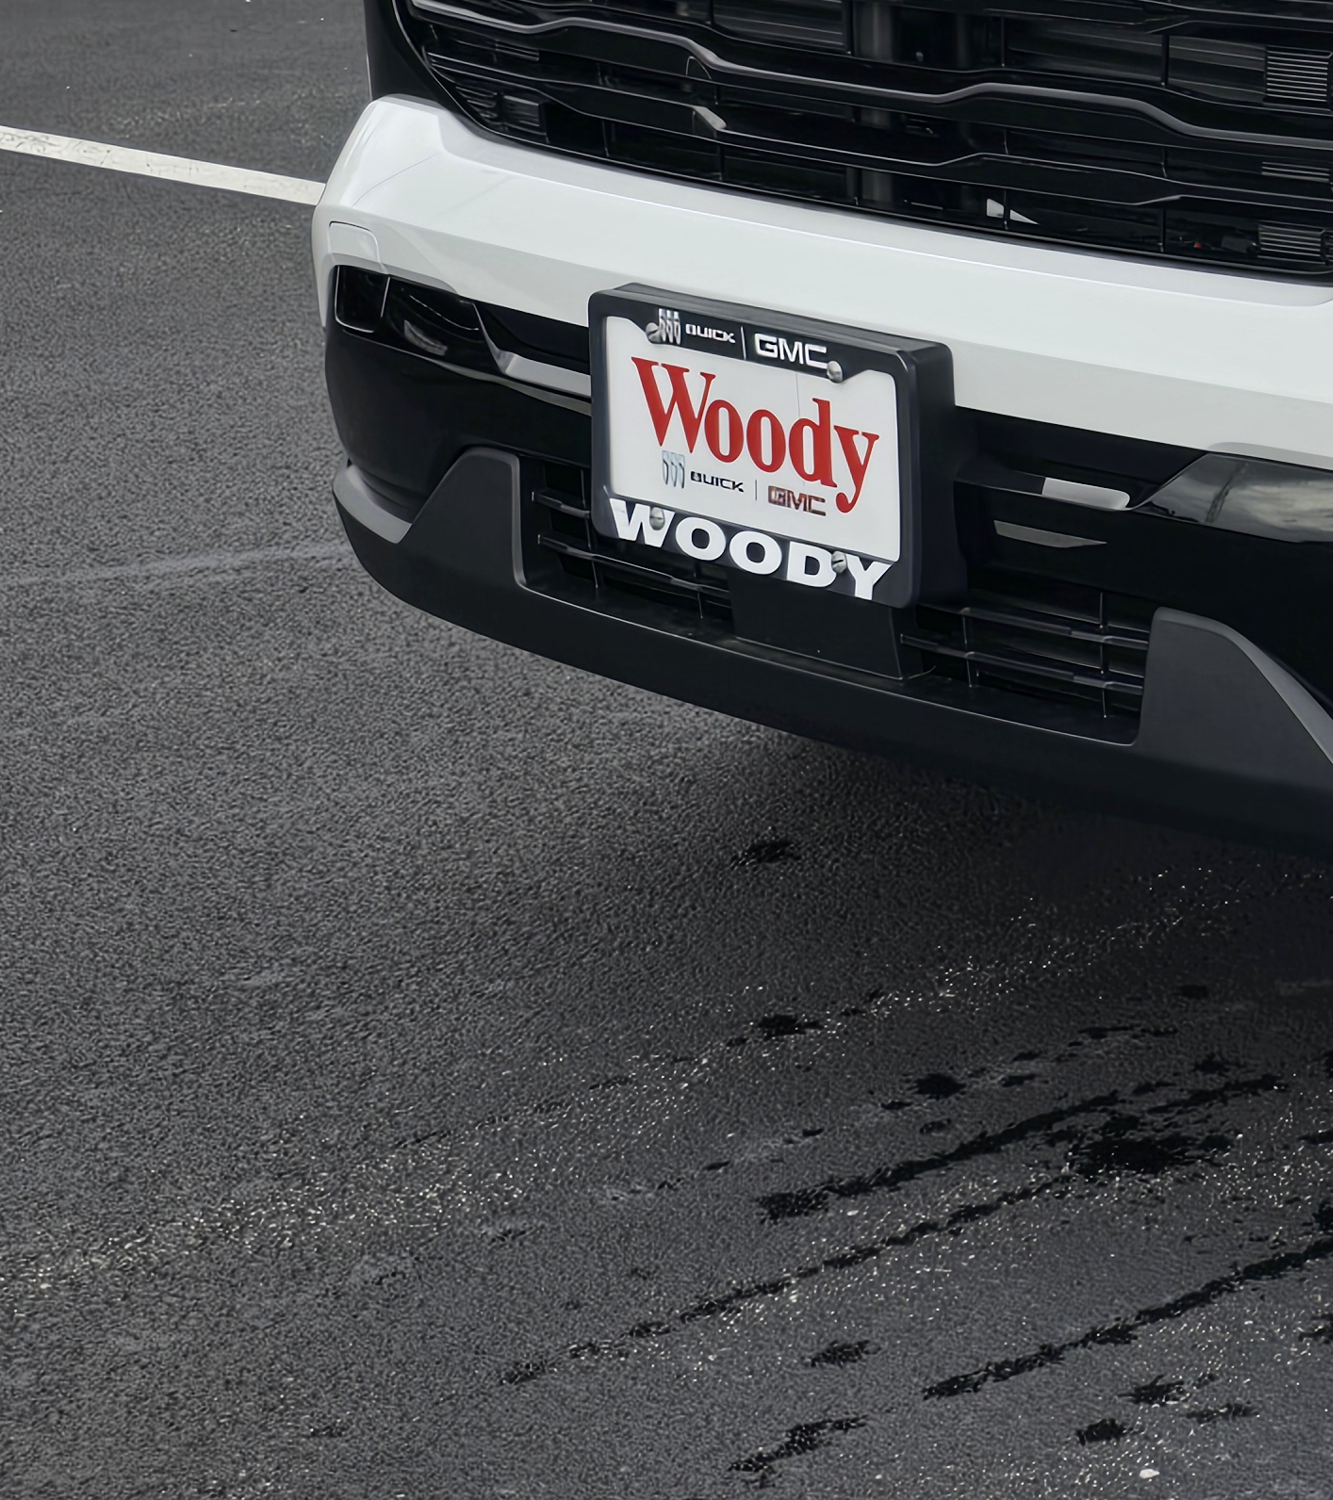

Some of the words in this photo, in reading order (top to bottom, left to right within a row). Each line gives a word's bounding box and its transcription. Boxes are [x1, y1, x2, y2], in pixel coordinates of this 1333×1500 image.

[685, 323, 736, 344] BUICK
[754, 332, 829, 369] GMC
[631, 356, 880, 514] Woody
[690, 470, 745, 493] BUICK
[767, 485, 827, 517] GMC
[609, 497, 894, 601] WOODY
